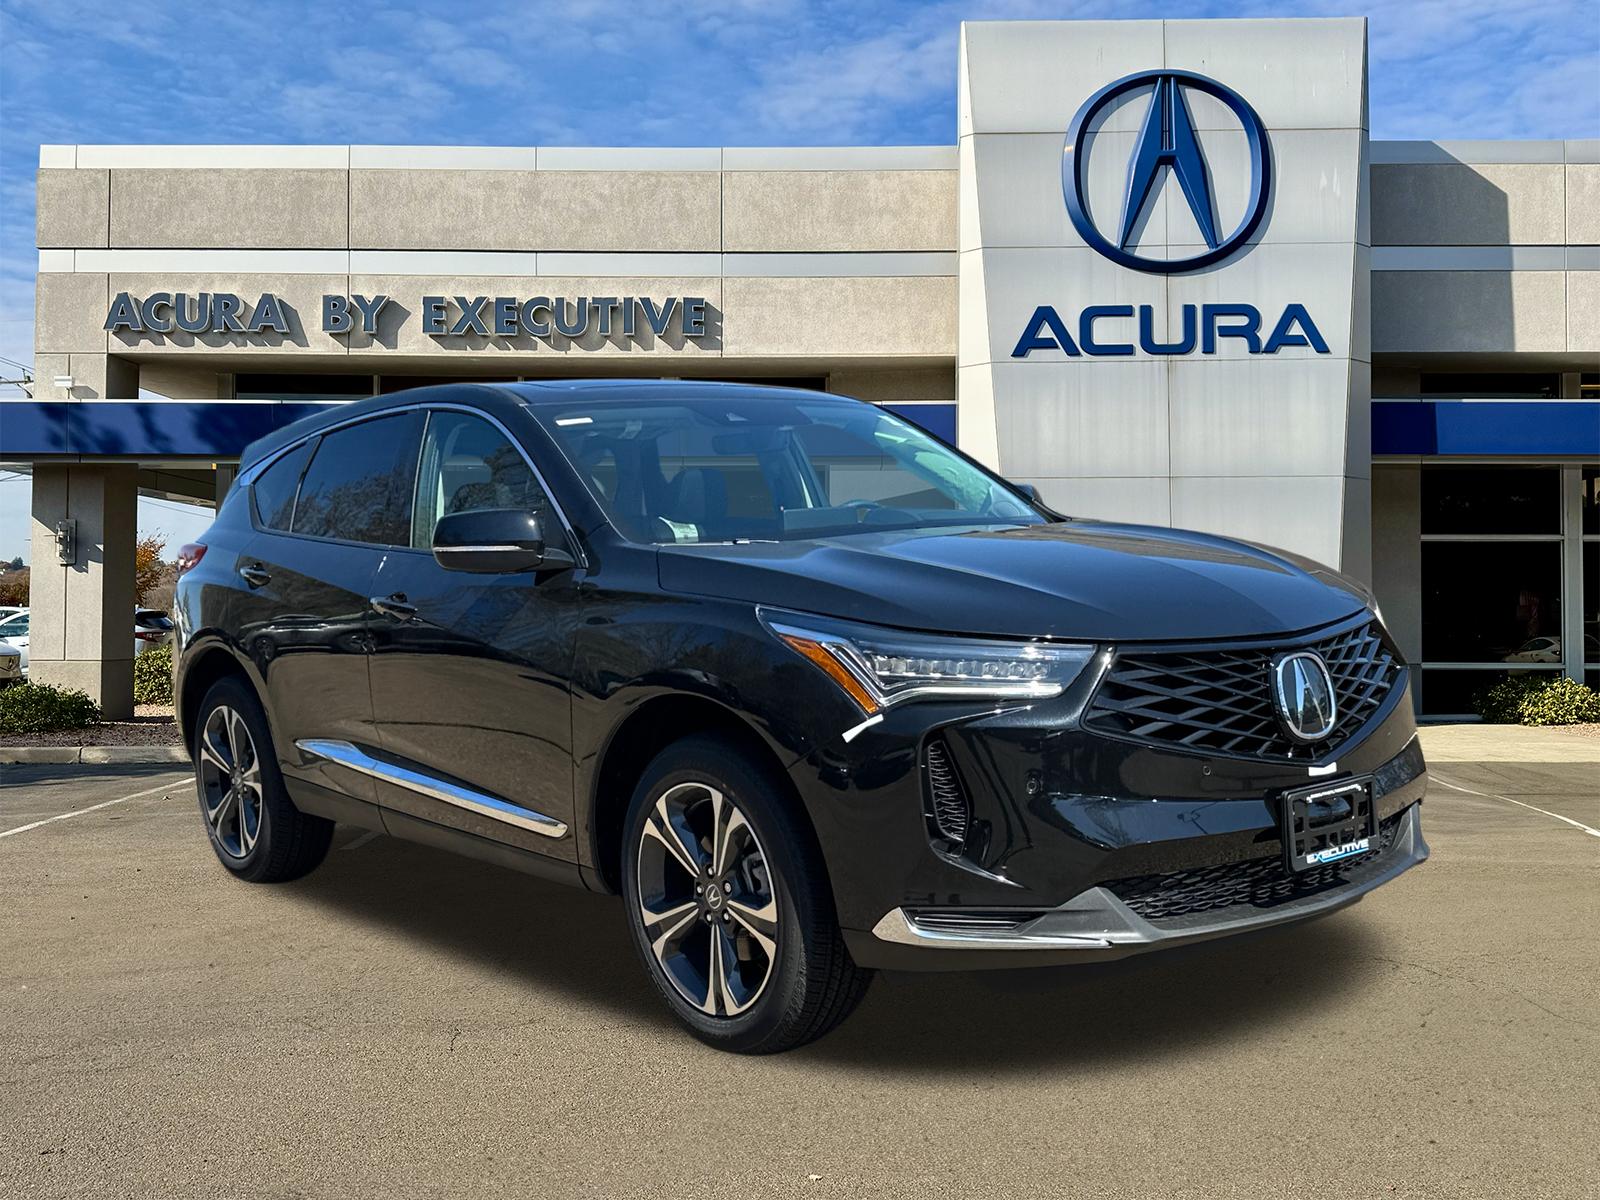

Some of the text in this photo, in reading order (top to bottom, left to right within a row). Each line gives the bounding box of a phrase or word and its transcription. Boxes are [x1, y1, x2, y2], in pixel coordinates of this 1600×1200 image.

[104, 291, 707, 337] ACURA BY EXECUTIVE
[1011, 303, 1332, 357] ACURA
[1306, 838, 1369, 864] EXECUTIVE
